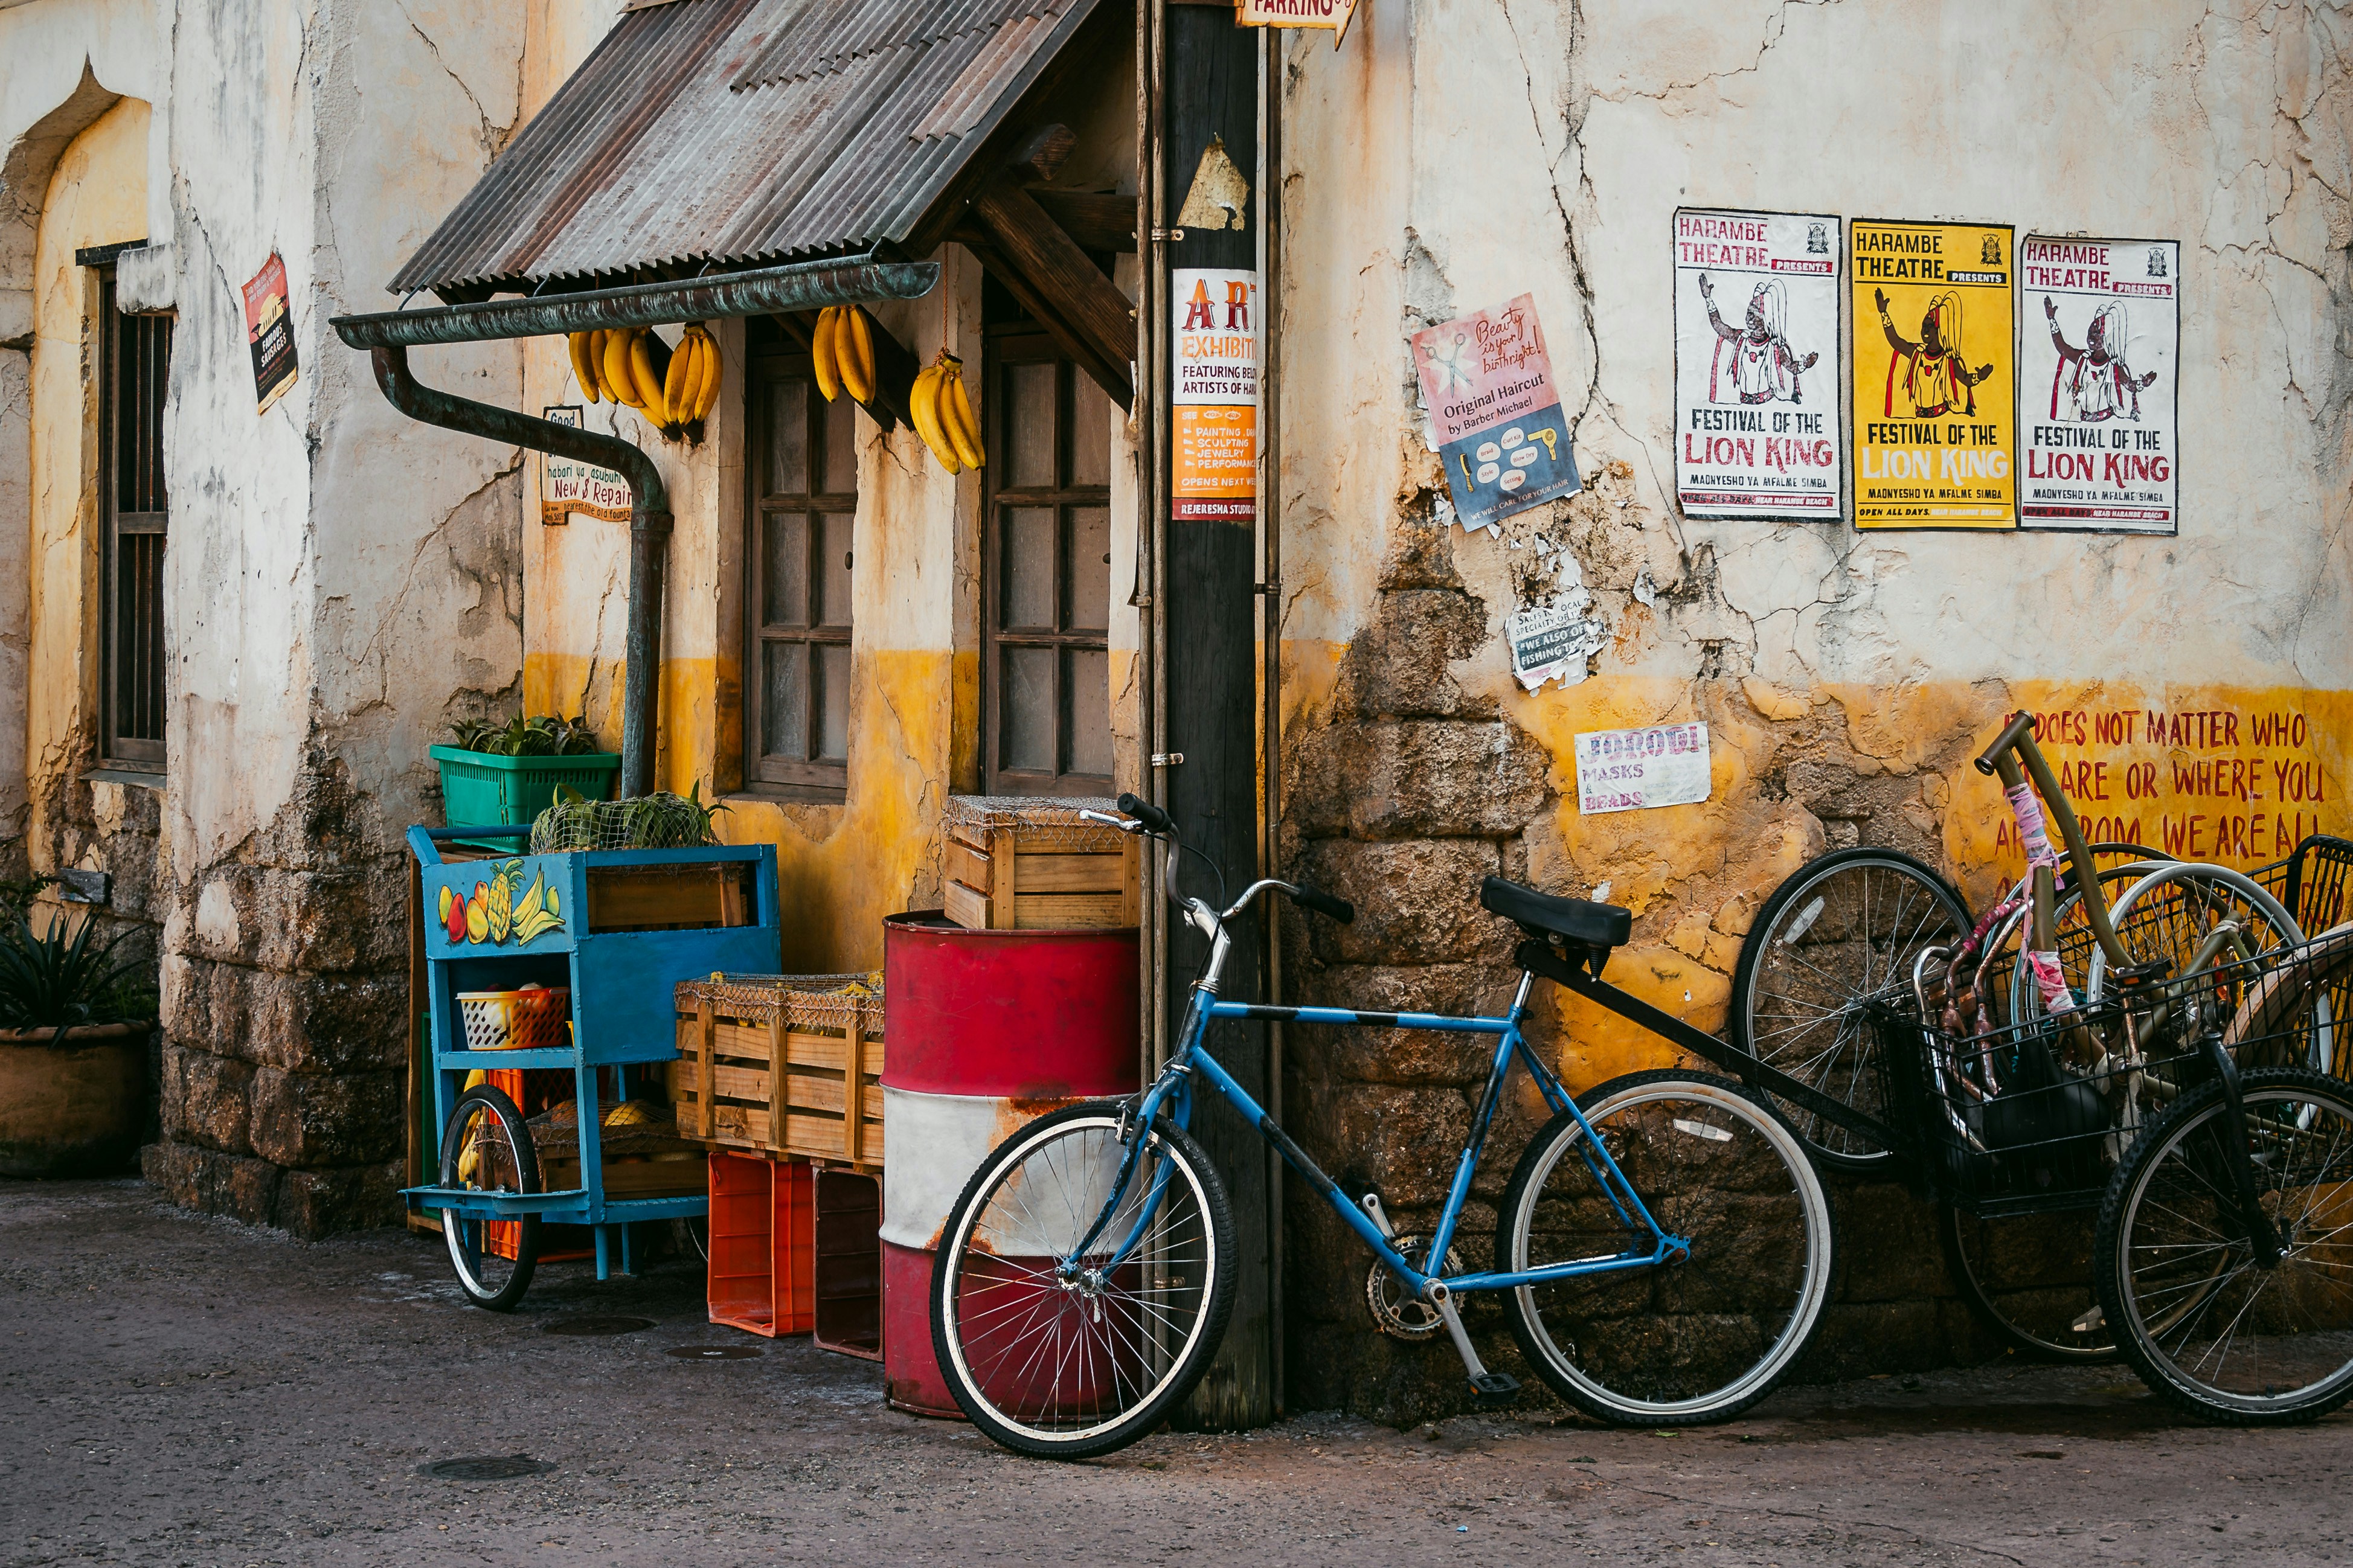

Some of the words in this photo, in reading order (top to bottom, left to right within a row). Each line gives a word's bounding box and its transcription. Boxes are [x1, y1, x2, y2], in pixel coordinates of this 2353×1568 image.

[1680, 218, 1767, 242] HARAMBE
[1857, 232, 1942, 254] HARAMBE
[1679, 242, 1768, 266] THEATRE
[2027, 242, 2109, 266] HARAMBE
[1776, 261, 1828, 271] PRESENTS
[1856, 257, 1944, 278] THEATRE
[1952, 272, 2002, 283] PRESENTS
[2026, 266, 2110, 290] THEATRE
[2117, 284, 2167, 295] PRESENTS
[262, 322, 283, 352] FAMOUS
[1475, 307, 1526, 348] Beauty
[261, 332, 287, 368] SAUSAGES
[1481, 342, 1495, 355] is
[1495, 333, 1516, 356] your
[1183, 365, 1240, 379] FEATURING
[1183, 382, 1228, 394] ARTISTS
[1231, 382, 1241, 394] OF
[1444, 389, 1495, 418] Original
[1497, 373, 1544, 400] Haircut
[1182, 411, 1198, 420] SEE
[1448, 424, 1461, 435] by
[1463, 412, 1494, 430] Barber
[1496, 396, 1533, 417] Michael
[1692, 409, 1765, 431] FESTIVAL
[1773, 412, 1790, 432] OF
[1796, 413, 1822, 434] THE
[1197, 438, 1249, 447] SCULPTING
[1868, 423, 1941, 444] FESTIVAL
[1948, 424, 1965, 445] OF
[1969, 424, 1997, 446] THE
[2034, 426, 2105, 449] FESTIVAL
[2112, 429, 2129, 449] OF
[2134, 430, 2160, 450] THE
[1197, 449, 1244, 458] JEWELRY
[1481, 447, 1494, 456] Braid
[1685, 433, 1754, 467] LION
[1765, 437, 1833, 474] KING
[548, 464, 572, 478] habari
[576, 466, 585, 479] ya
[1481, 469, 1494, 478] Style
[1862, 447, 1931, 480] LION
[1941, 448, 2008, 487] KING
[2028, 449, 2095, 482] LION
[2104, 453, 2169, 489] KING
[555, 479, 579, 498] New
[1181, 478, 1218, 487] OPENS
[1221, 478, 1244, 487] NEXT
[1504, 476, 1521, 484] Setting
[1690, 475, 1744, 486] MAONYESHO
[1747, 476, 1759, 486] YA
[1763, 477, 1797, 487] MFALME
[1802, 478, 1827, 488] SIMBA
[1471, 512, 1482, 520] WE
[1481, 505, 1498, 516] WILL
[1498, 498, 1517, 509] CARE
[1518, 492, 1532, 502] FOR
[1532, 486, 1552, 498] YOUR
[1552, 479, 1568, 490] HAIR
[1868, 488, 1921, 499] MAONYESHO
[1923, 489, 1934, 498] YA
[1939, 489, 1972, 499] MFALME
[1976, 490, 2002, 499] SIMBA
[2032, 488, 2083, 500] MAONYESHO
[2087, 490, 2097, 500] YA
[2101, 491, 2134, 501] MFALME
[2139, 492, 2163, 502] SIMBA
[564, 502, 583, 511] nearest
[585, 505, 595, 514] the
[597, 509, 608, 518] old
[1181, 504, 1228, 514] REJERESHA
[1230, 504, 1251, 515] STUDIO
[1516, 618, 1554, 636] SPECIALTY
[1544, 630, 1568, 646] ALSO
[1521, 645, 1562, 665] FISHING
[2035, 711, 2087, 746] DOES
[2095, 710, 2141, 746] NOT
[2146, 709, 2239, 749] MATTER
[2252, 711, 2306, 749] WHO
[1582, 763, 1644, 782] MASKS
[2061, 760, 2109, 801] ARE
[2126, 761, 2159, 800] OR
[2172, 758, 2264, 802] WHERE
[2274, 757, 2325, 803] YOU
[1585, 791, 1643, 811] BEADS
[2063, 815, 2142, 859] ROM
[2163, 812, 2207, 857] WE
[2215, 814, 2266, 860] ARE
